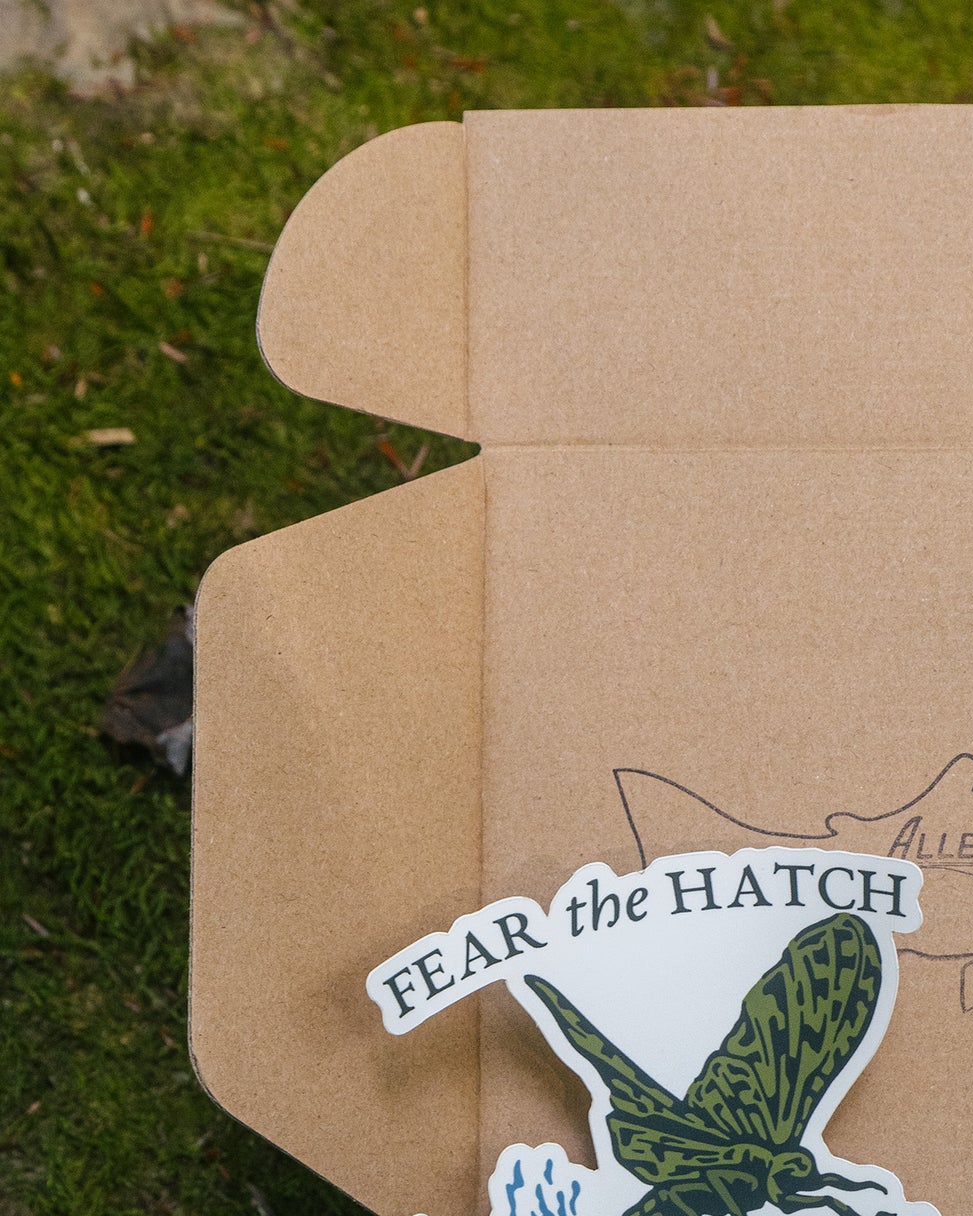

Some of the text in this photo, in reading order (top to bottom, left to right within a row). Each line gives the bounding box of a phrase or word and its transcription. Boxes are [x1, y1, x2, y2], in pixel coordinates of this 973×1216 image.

[382, 862, 907, 1018] FEAR the HATCH
